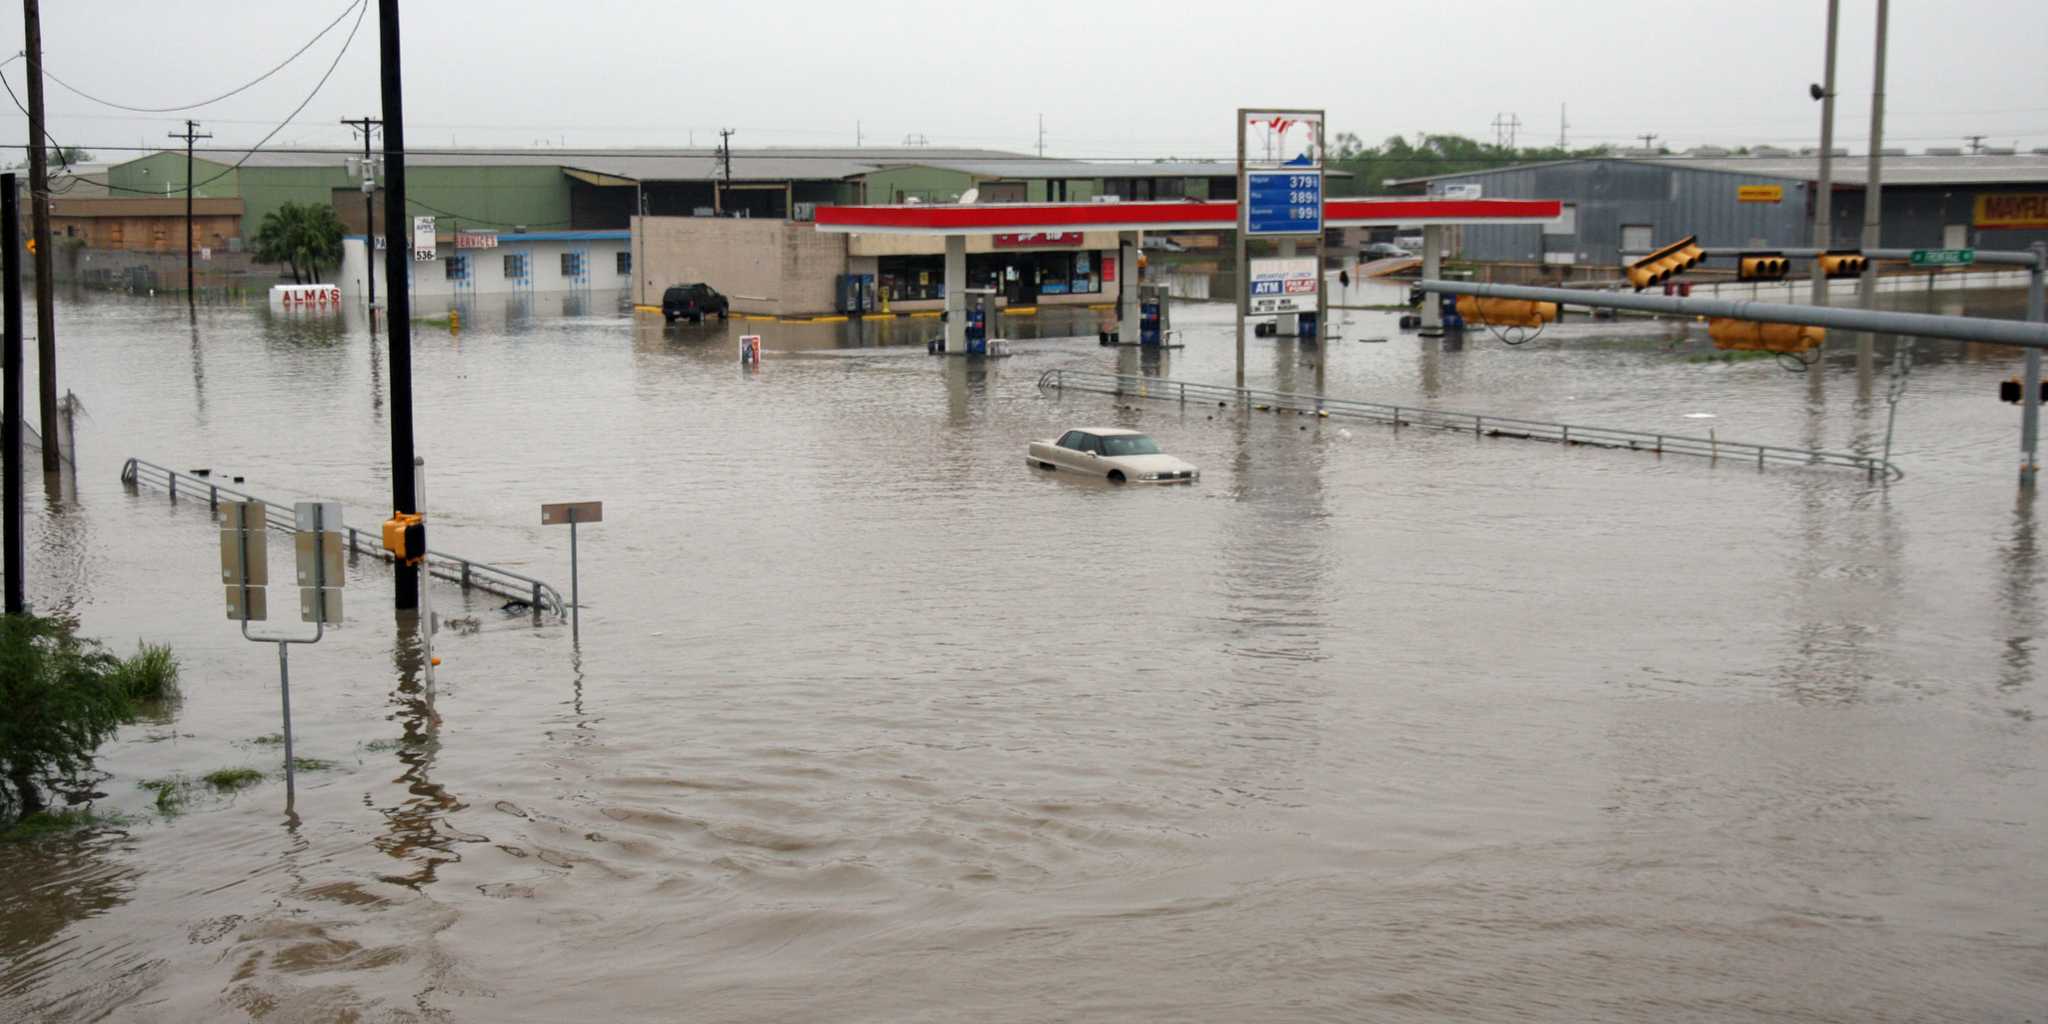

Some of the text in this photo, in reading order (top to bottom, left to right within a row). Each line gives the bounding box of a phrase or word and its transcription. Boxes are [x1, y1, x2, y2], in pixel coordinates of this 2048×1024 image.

[1290, 176, 1312, 188] 379
[1290, 192, 1313, 204] 389
[1255, 282, 1279, 294] ATM
[283, 287, 340, 304] ALMAS
